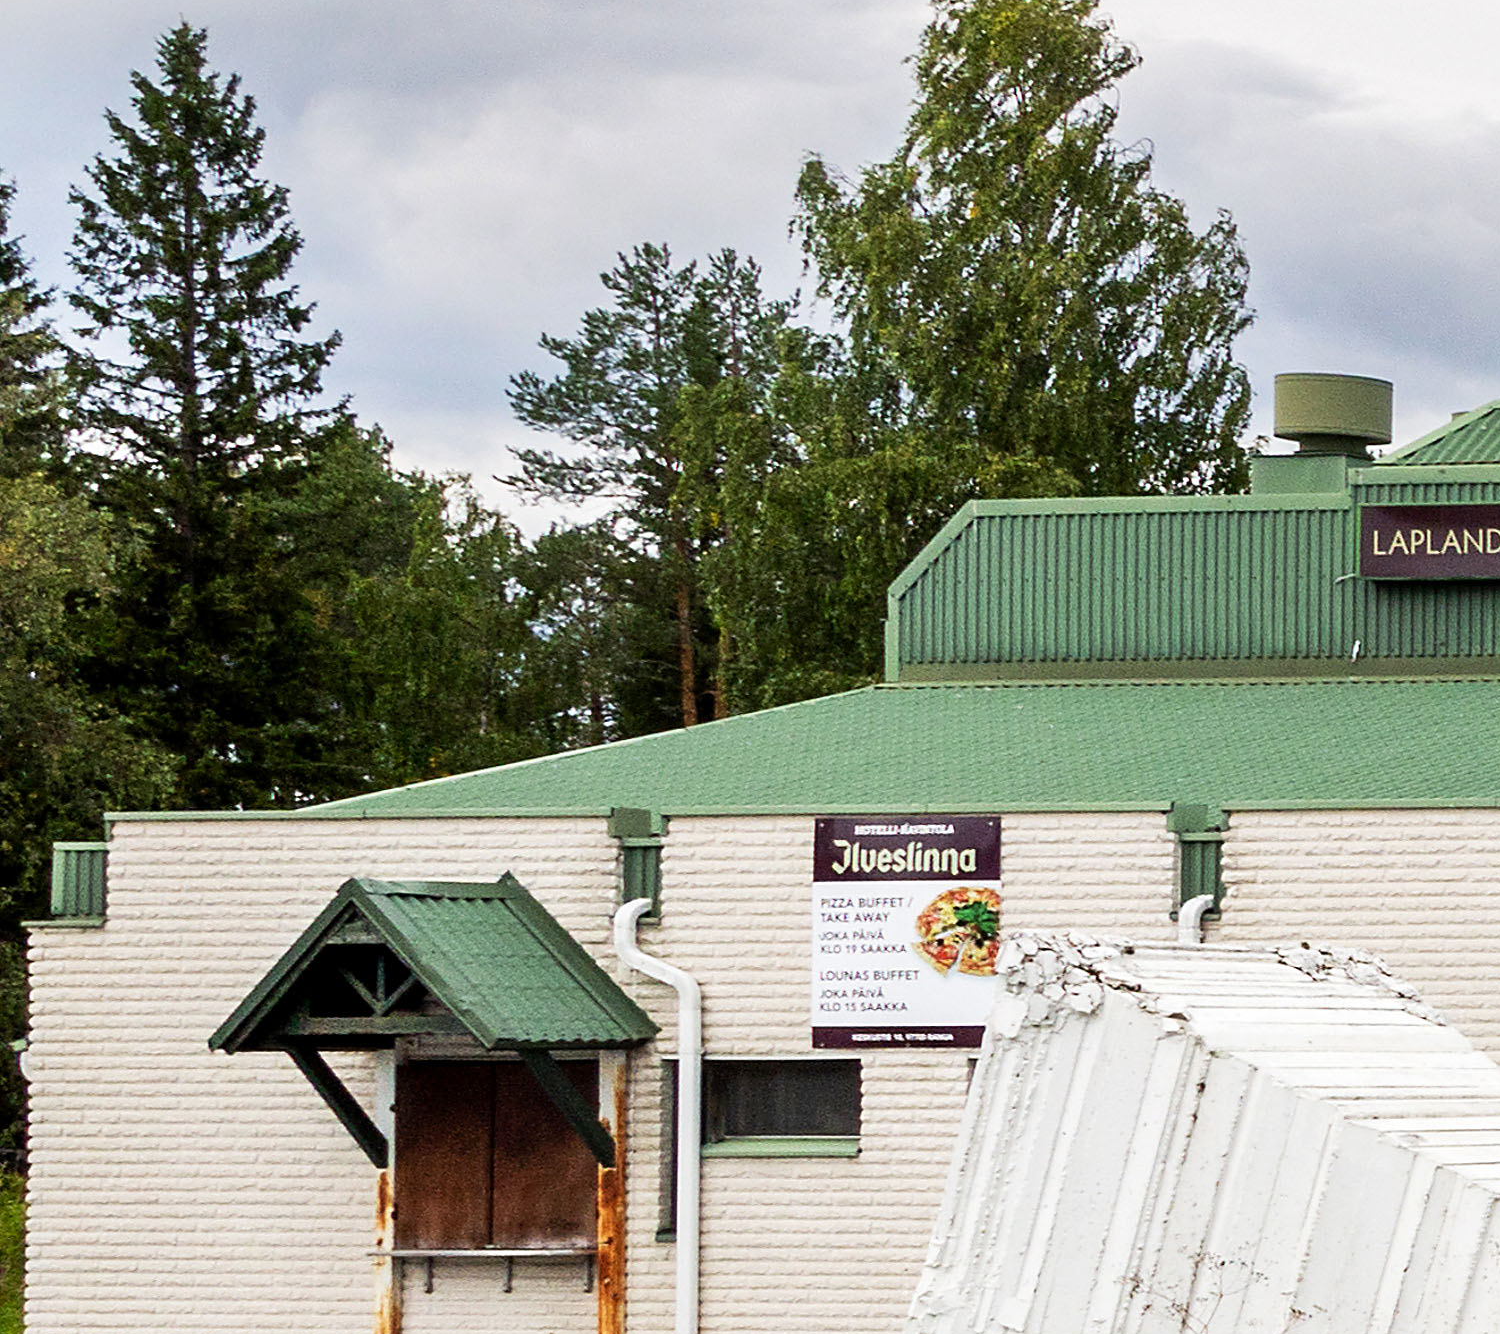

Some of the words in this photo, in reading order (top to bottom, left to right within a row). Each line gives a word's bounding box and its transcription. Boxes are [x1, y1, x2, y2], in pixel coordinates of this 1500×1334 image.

[820, 898, 854, 908] PIZZA
[858, 898, 904, 908] BUFFET
[820, 913, 849, 922] TAKE
[854, 912, 890, 922] AWAY
[819, 931, 848, 941] JOKA
[820, 944, 841, 954] KLO
[860, 944, 907, 954] SAAKKA
[820, 970, 870, 981] LOUNAS
[873, 970, 920, 980] BUFFET
[819, 989, 848, 999] JOKA
[820, 1002, 841, 1012] KLO
[845, 1002, 857, 1012] 15
[860, 1002, 908, 1012] SAAKKA
